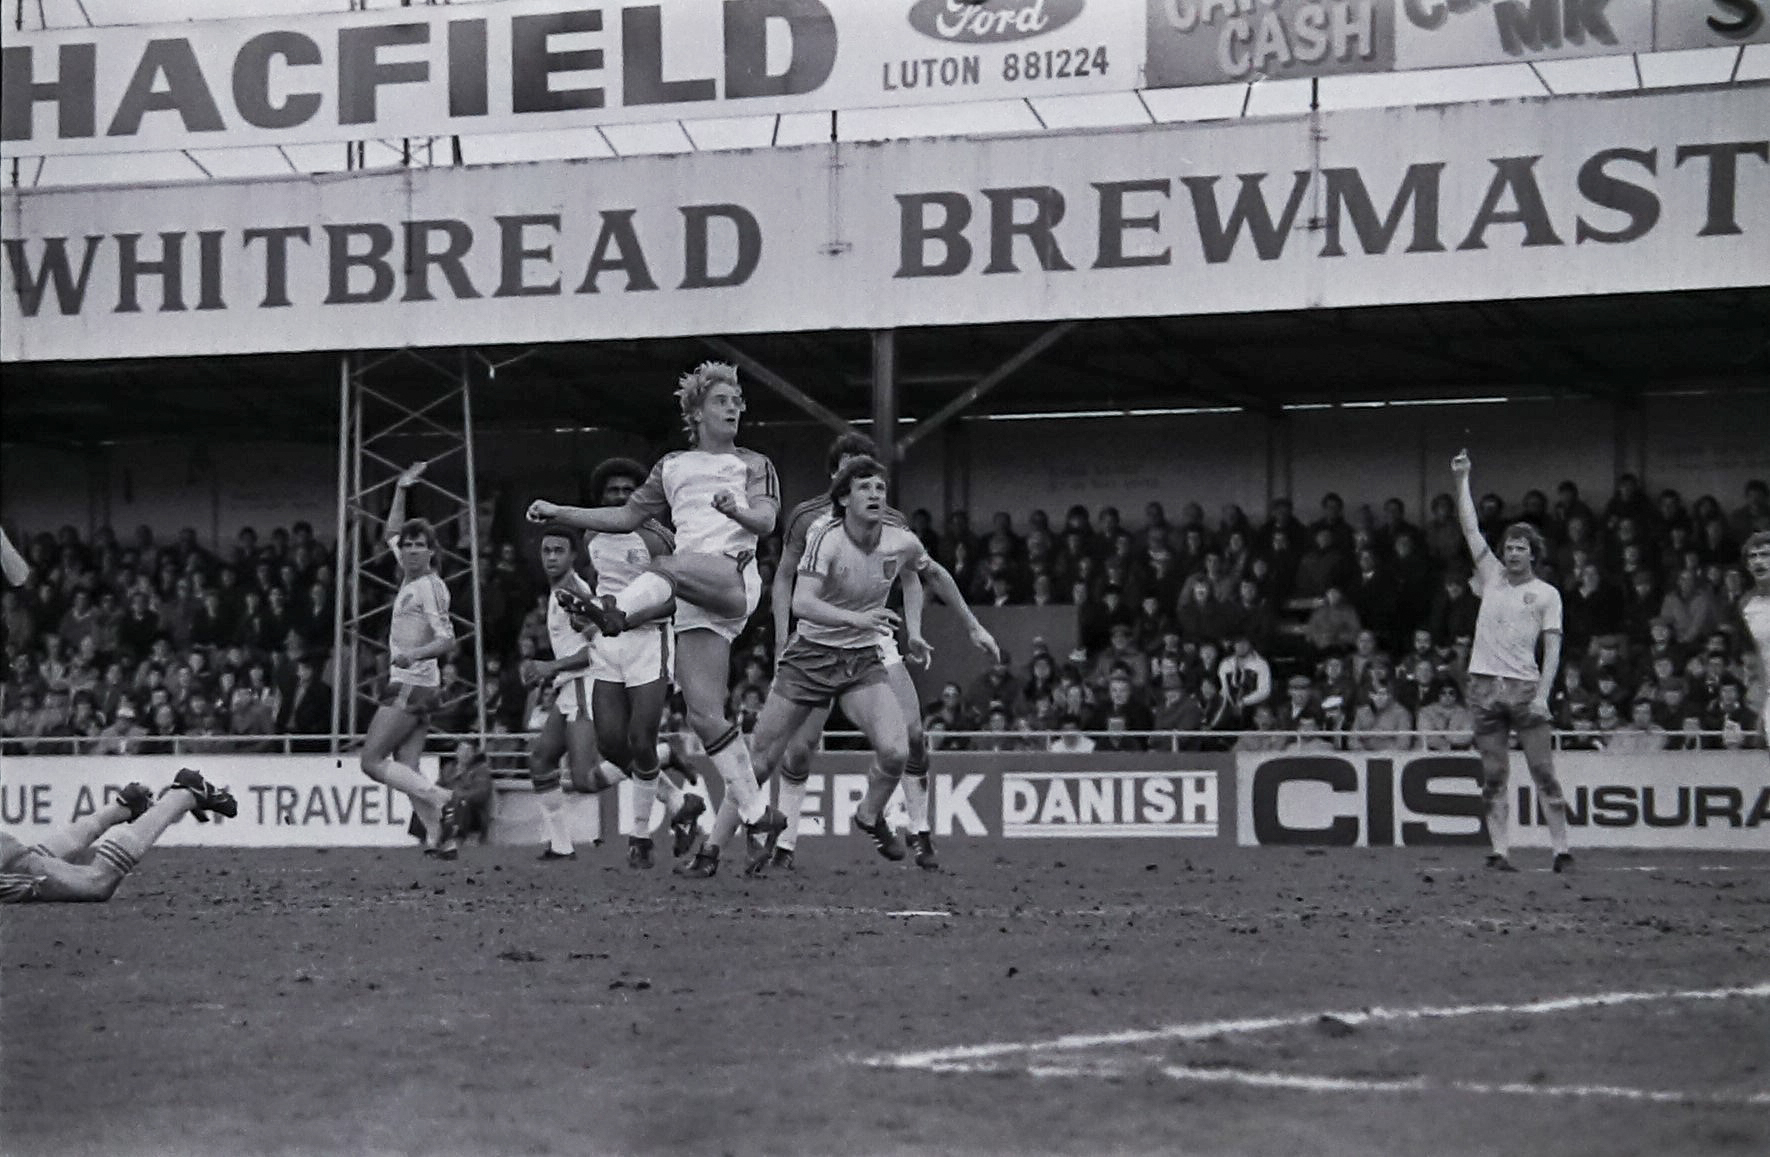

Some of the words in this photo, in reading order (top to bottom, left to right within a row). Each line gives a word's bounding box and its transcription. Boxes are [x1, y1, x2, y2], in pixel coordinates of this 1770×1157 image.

[936, 0, 1049, 37] Ford
[1217, 0, 1376, 80] CASH
[1, 0, 839, 141] HACFIELD
[882, 55, 981, 91] LUTON
[1003, 45, 1110, 82] 881224
[2, 202, 764, 318] WHITBREAD
[893, 141, 1769, 279] BREWMAST
[249, 783, 406, 826] TRAVEL
[1004, 776, 1218, 824] DANISH
[1252, 756, 1492, 846] CIS
